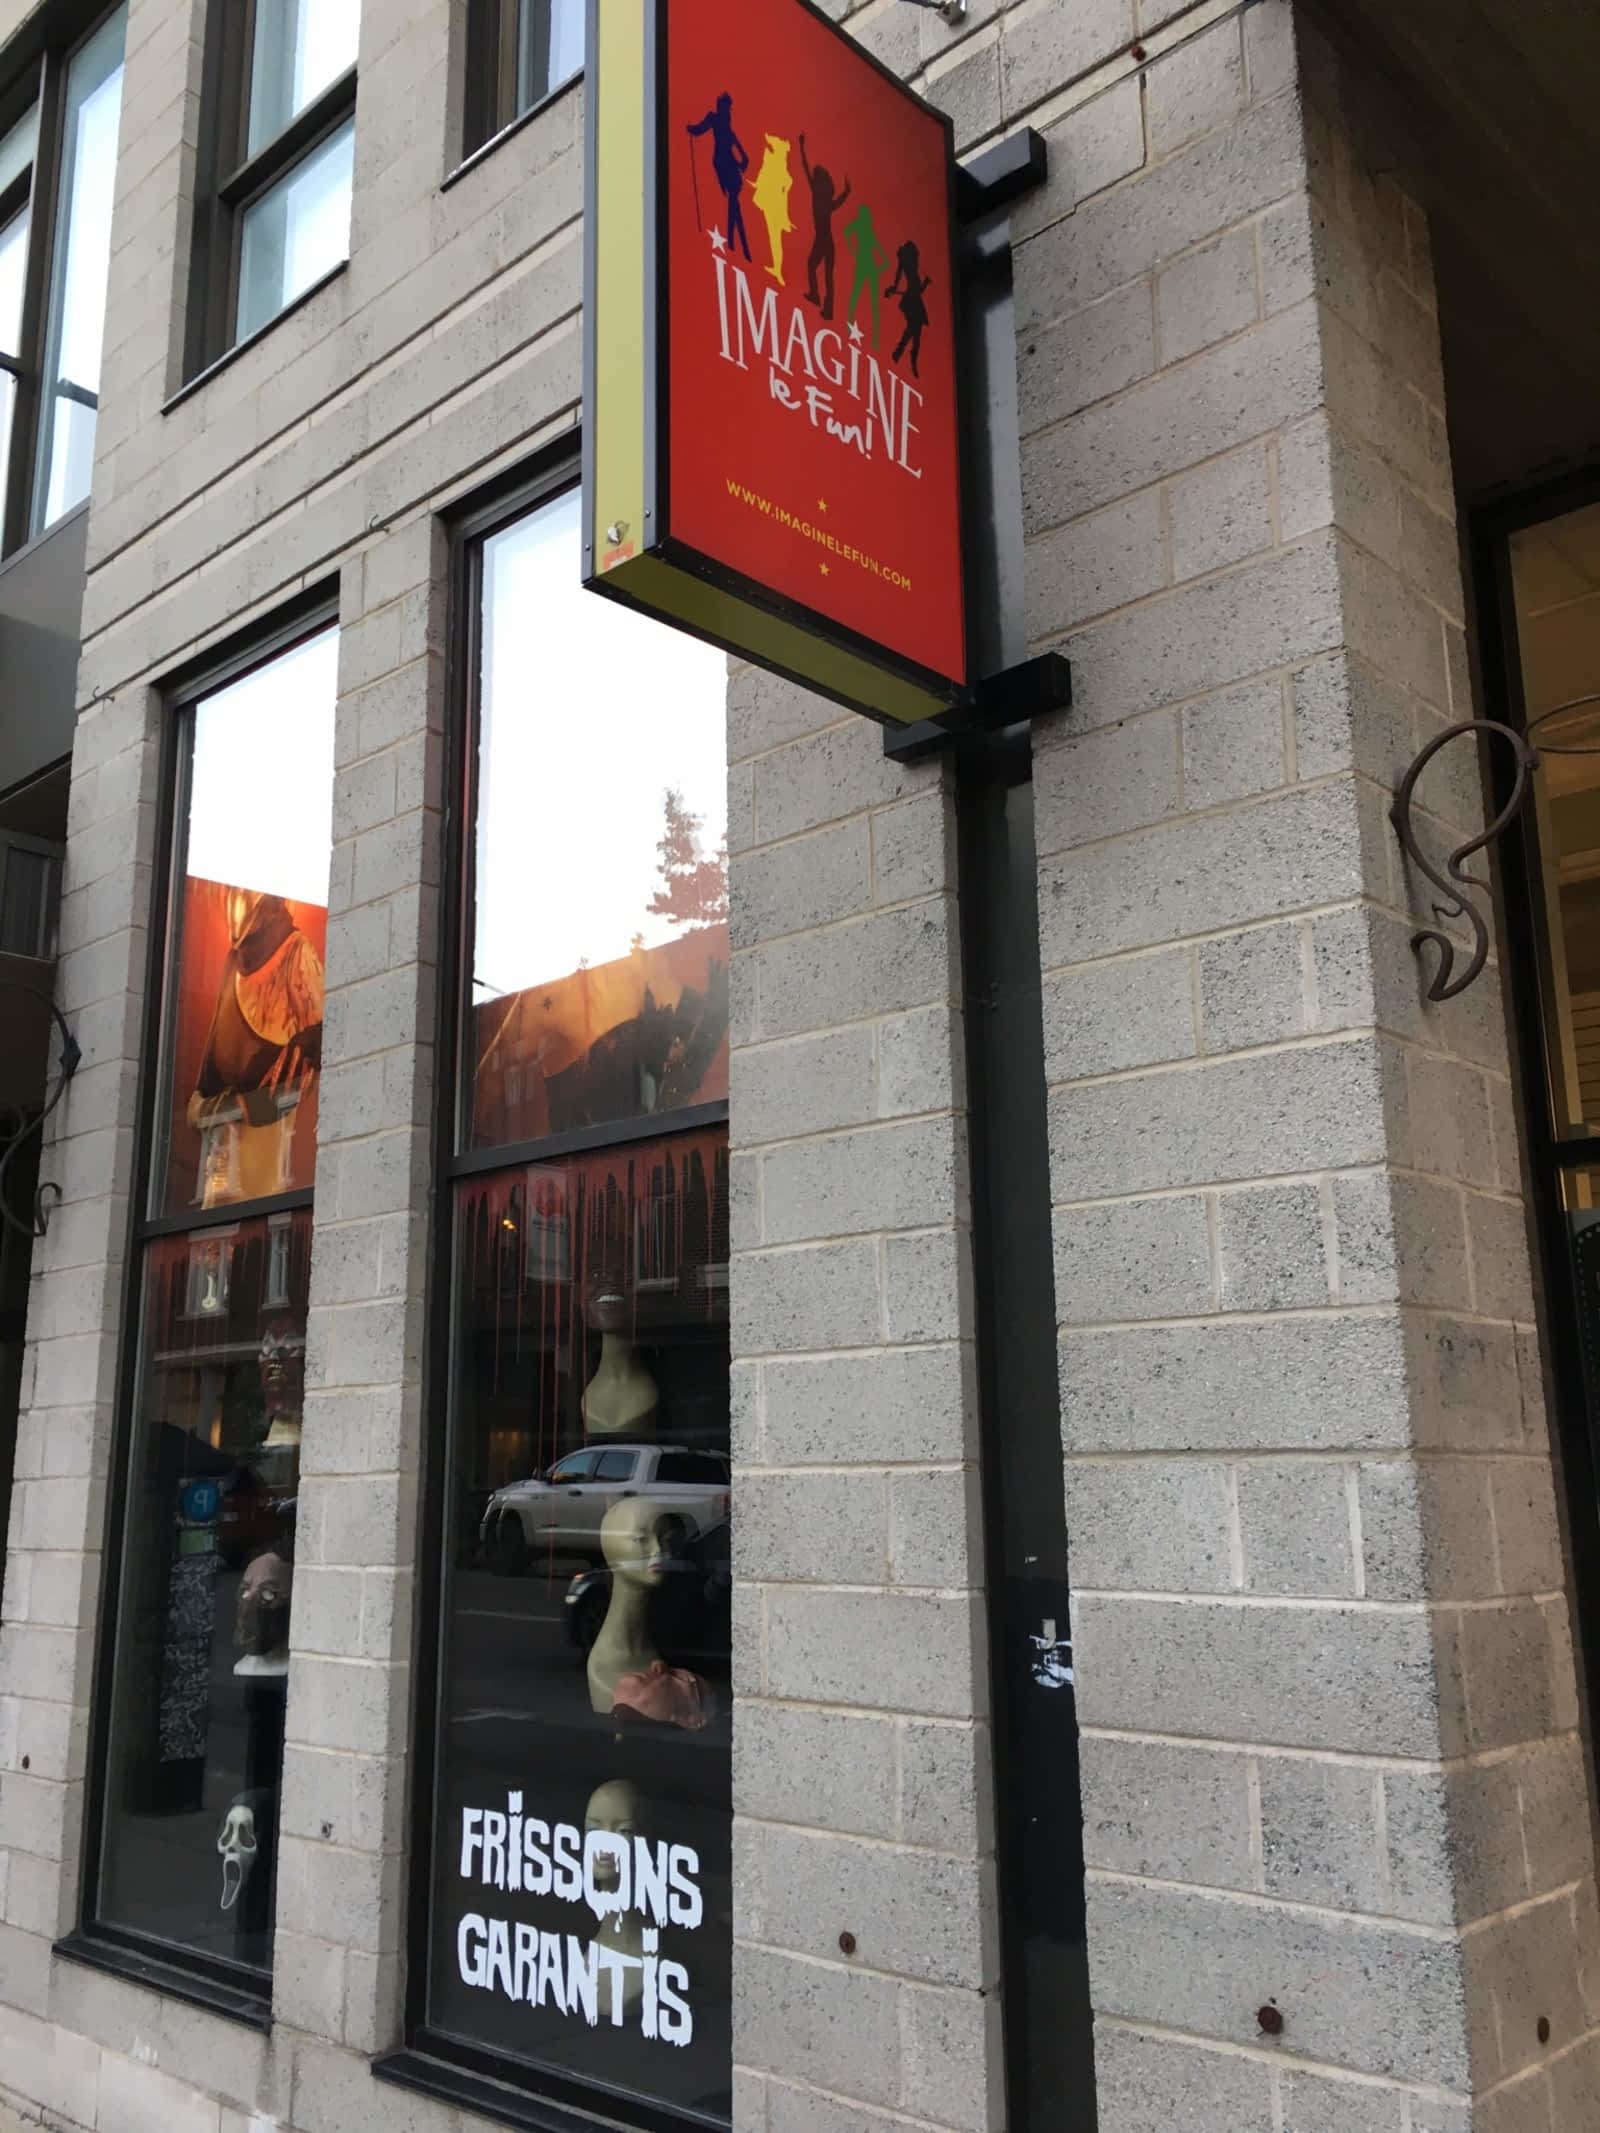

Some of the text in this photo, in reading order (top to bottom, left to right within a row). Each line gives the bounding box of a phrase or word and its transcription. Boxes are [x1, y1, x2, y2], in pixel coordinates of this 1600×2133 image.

[711, 252, 923, 478] IMAGINE
[805, 385, 873, 459] Fun!
[726, 477, 912, 591] WWW.IMAGINELEFUN.COM
[460, 1790, 703, 1930] FRISSONS
[457, 1912, 693, 2048] GARANTIS
